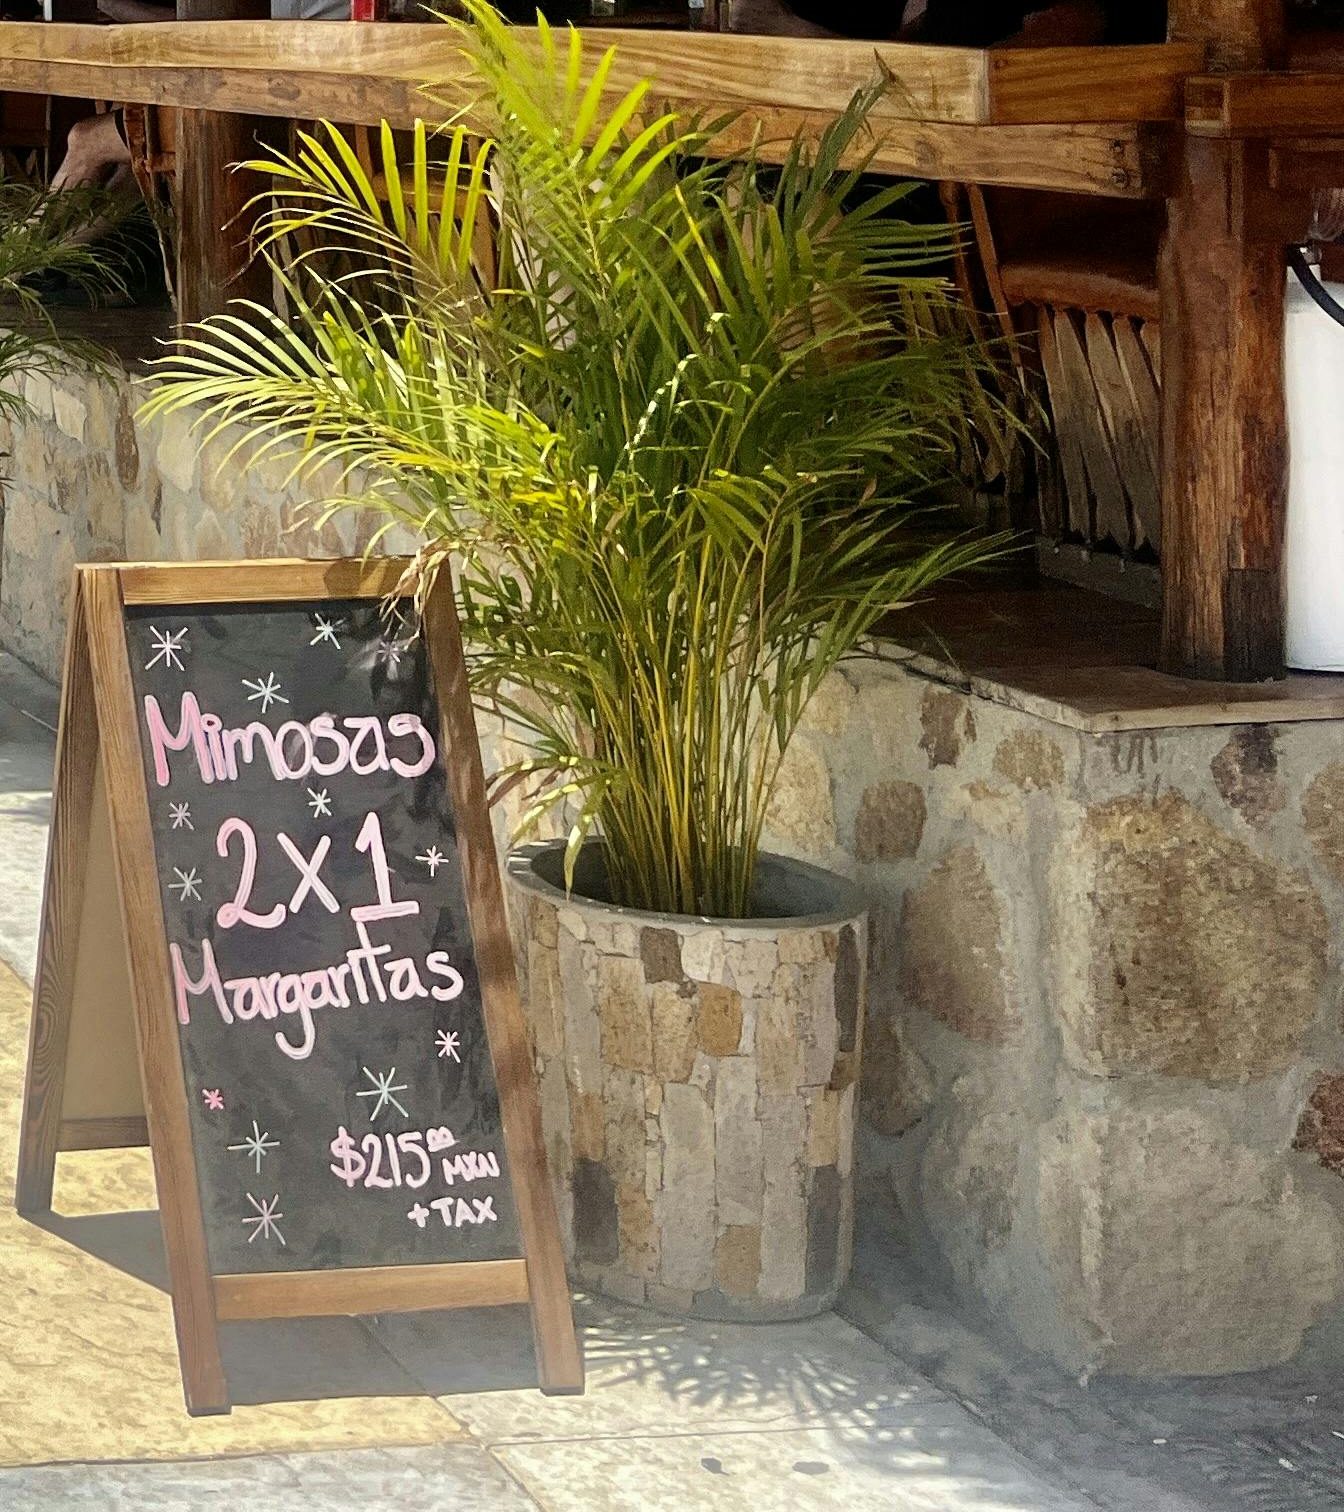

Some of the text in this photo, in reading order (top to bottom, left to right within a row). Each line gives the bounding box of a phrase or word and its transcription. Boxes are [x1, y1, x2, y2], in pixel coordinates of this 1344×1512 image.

[143, 690, 437, 788] Mimosas
[169, 920, 464, 1061] Margaritas
[442, 1150, 501, 1186] MXN
